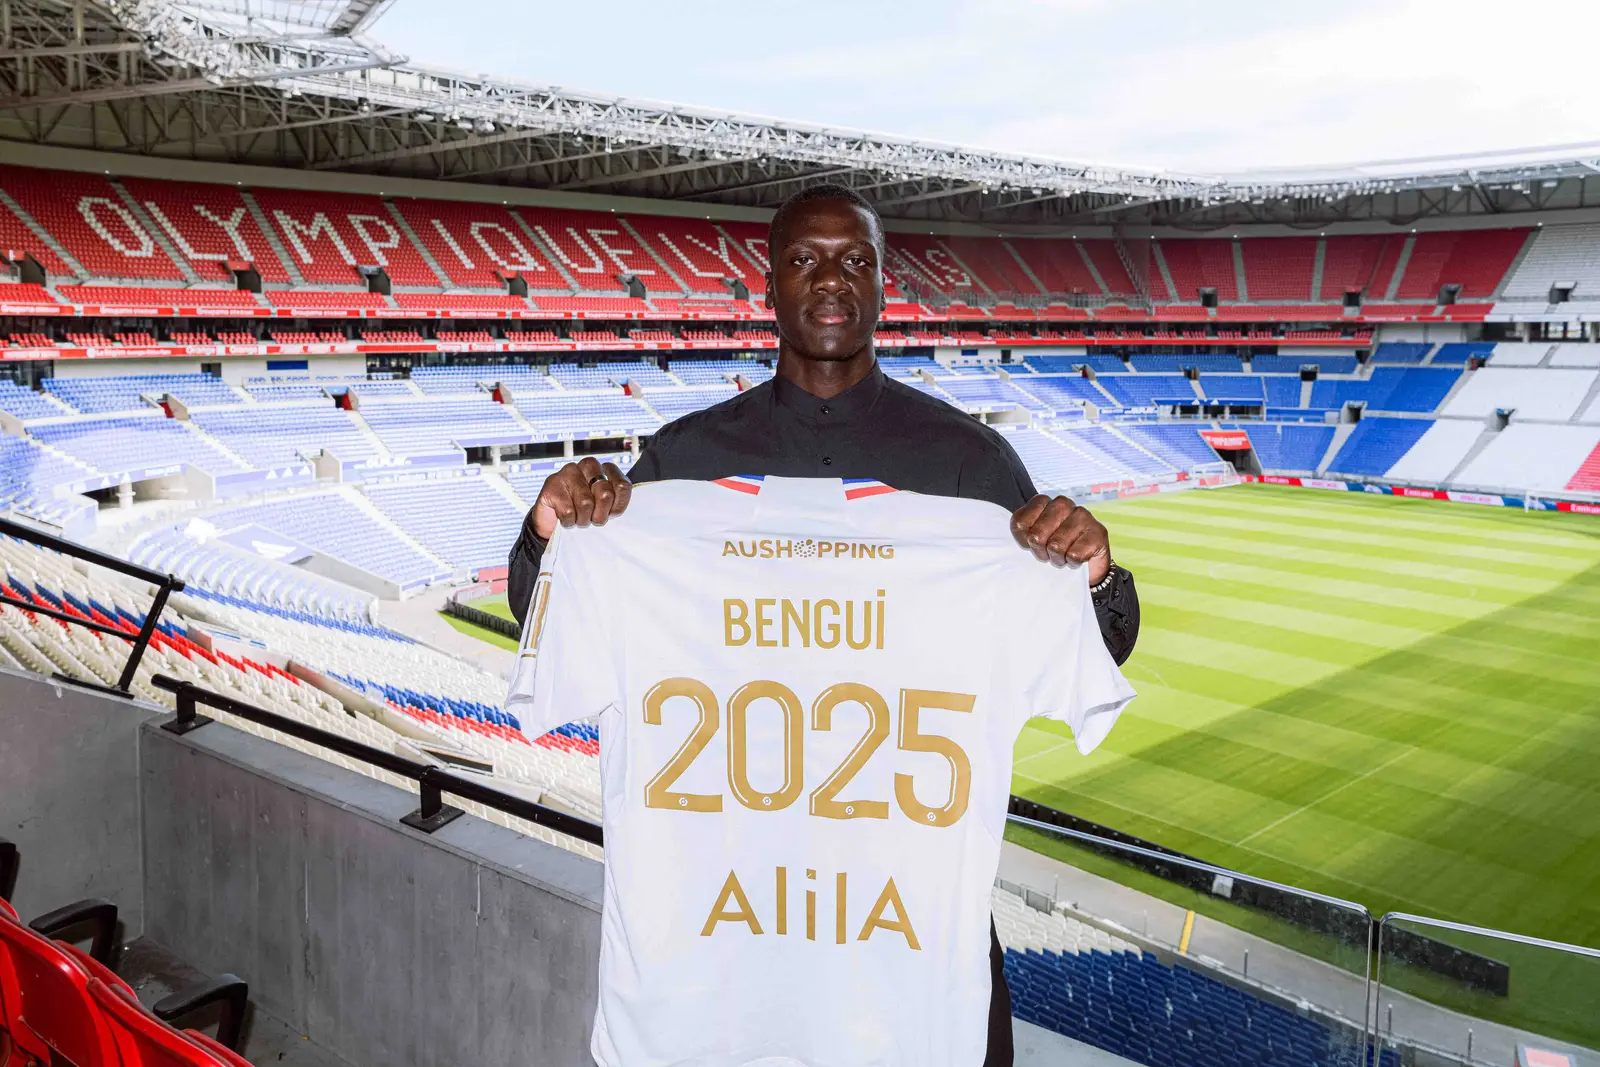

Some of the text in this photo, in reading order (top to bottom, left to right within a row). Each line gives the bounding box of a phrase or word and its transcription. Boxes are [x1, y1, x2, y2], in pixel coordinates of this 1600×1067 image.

[77, 196, 656, 276] OLYMPIQUE
[722, 539, 894, 559] AUSHOPPING
[642, 677, 977, 828] 2025
